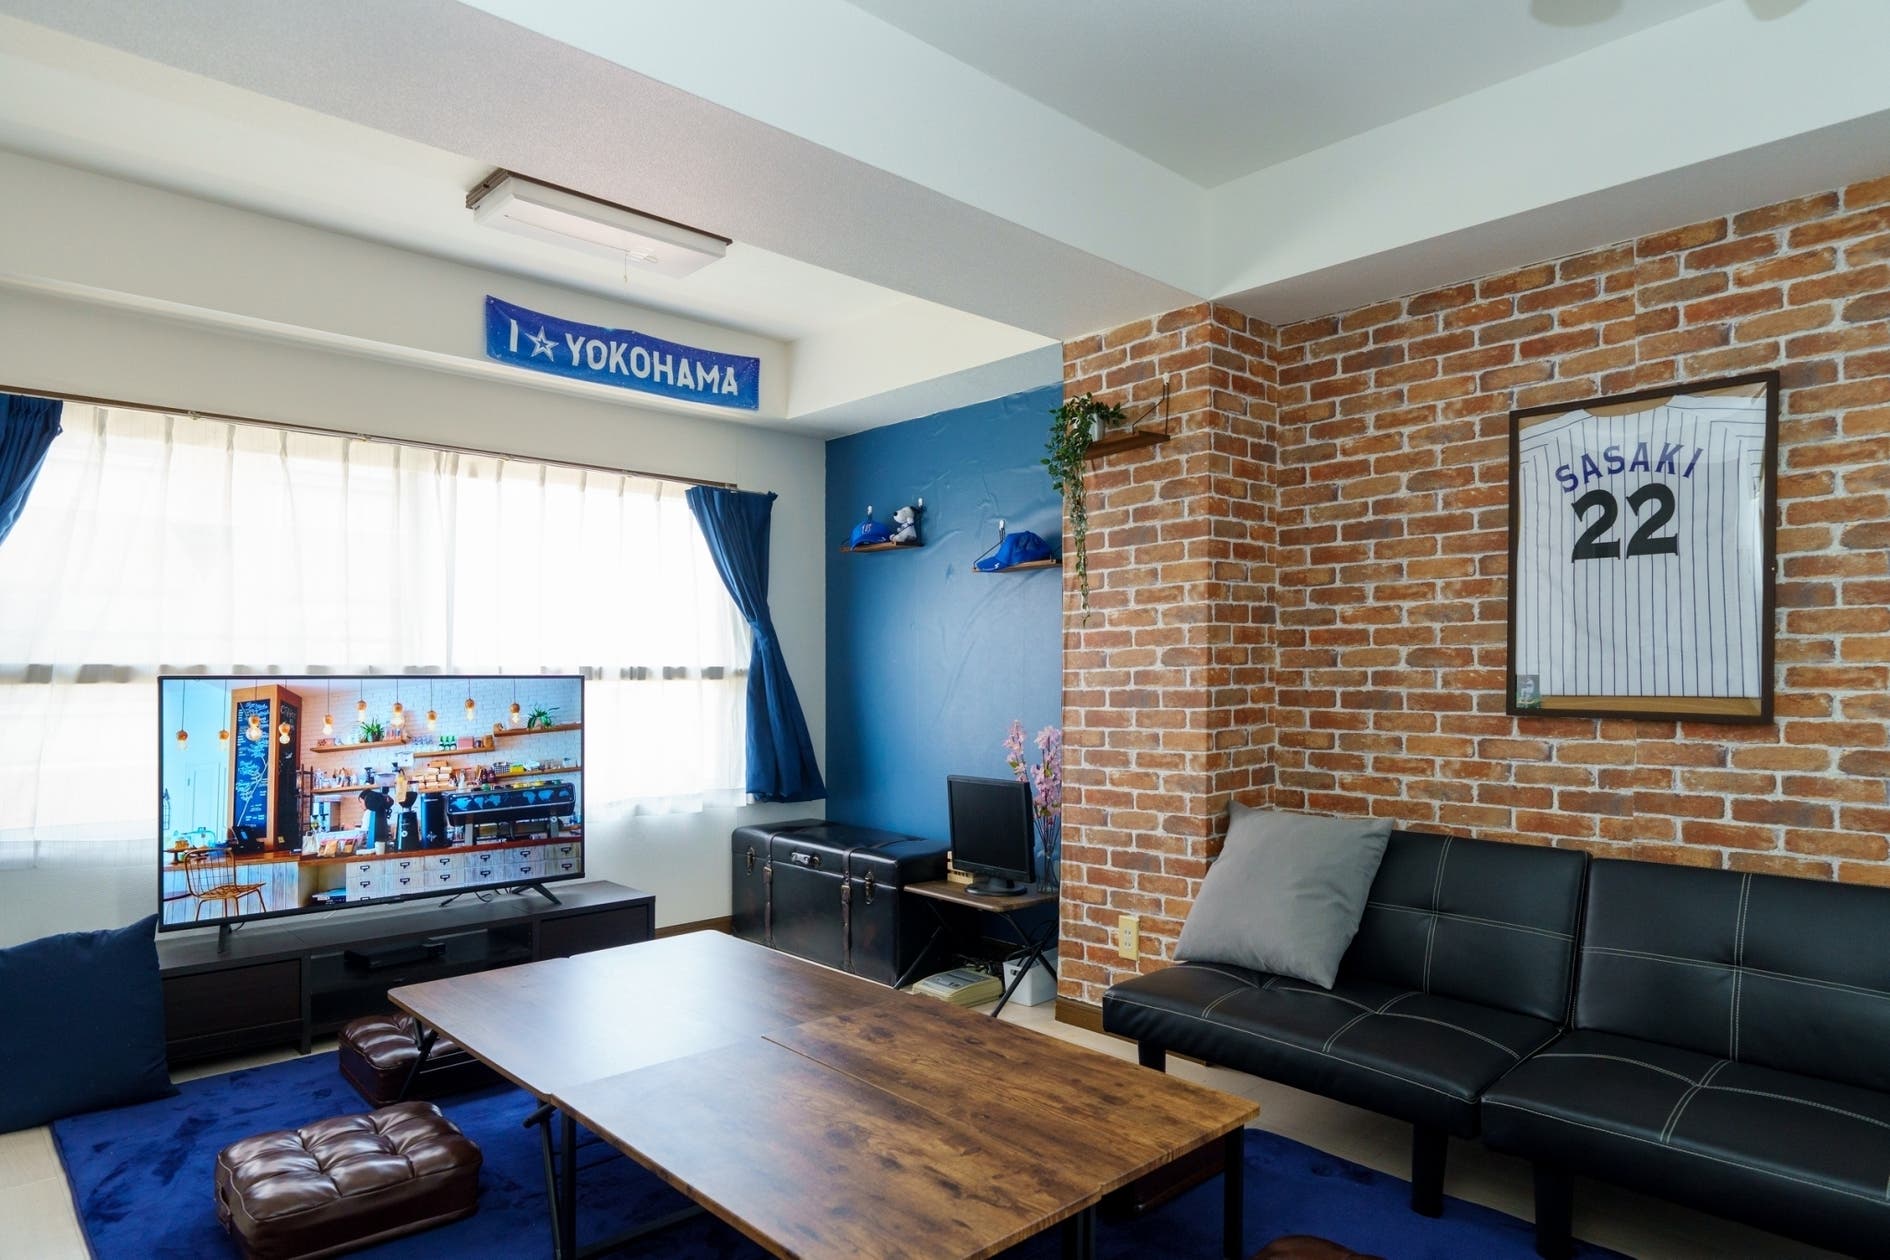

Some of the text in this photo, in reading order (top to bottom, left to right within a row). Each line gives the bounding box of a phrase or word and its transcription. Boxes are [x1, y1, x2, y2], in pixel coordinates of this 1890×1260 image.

[510, 319, 738, 395] I YOKOHAMA
[1555, 442, 1703, 492] SASAKI
[1571, 482, 1678, 563] 22
